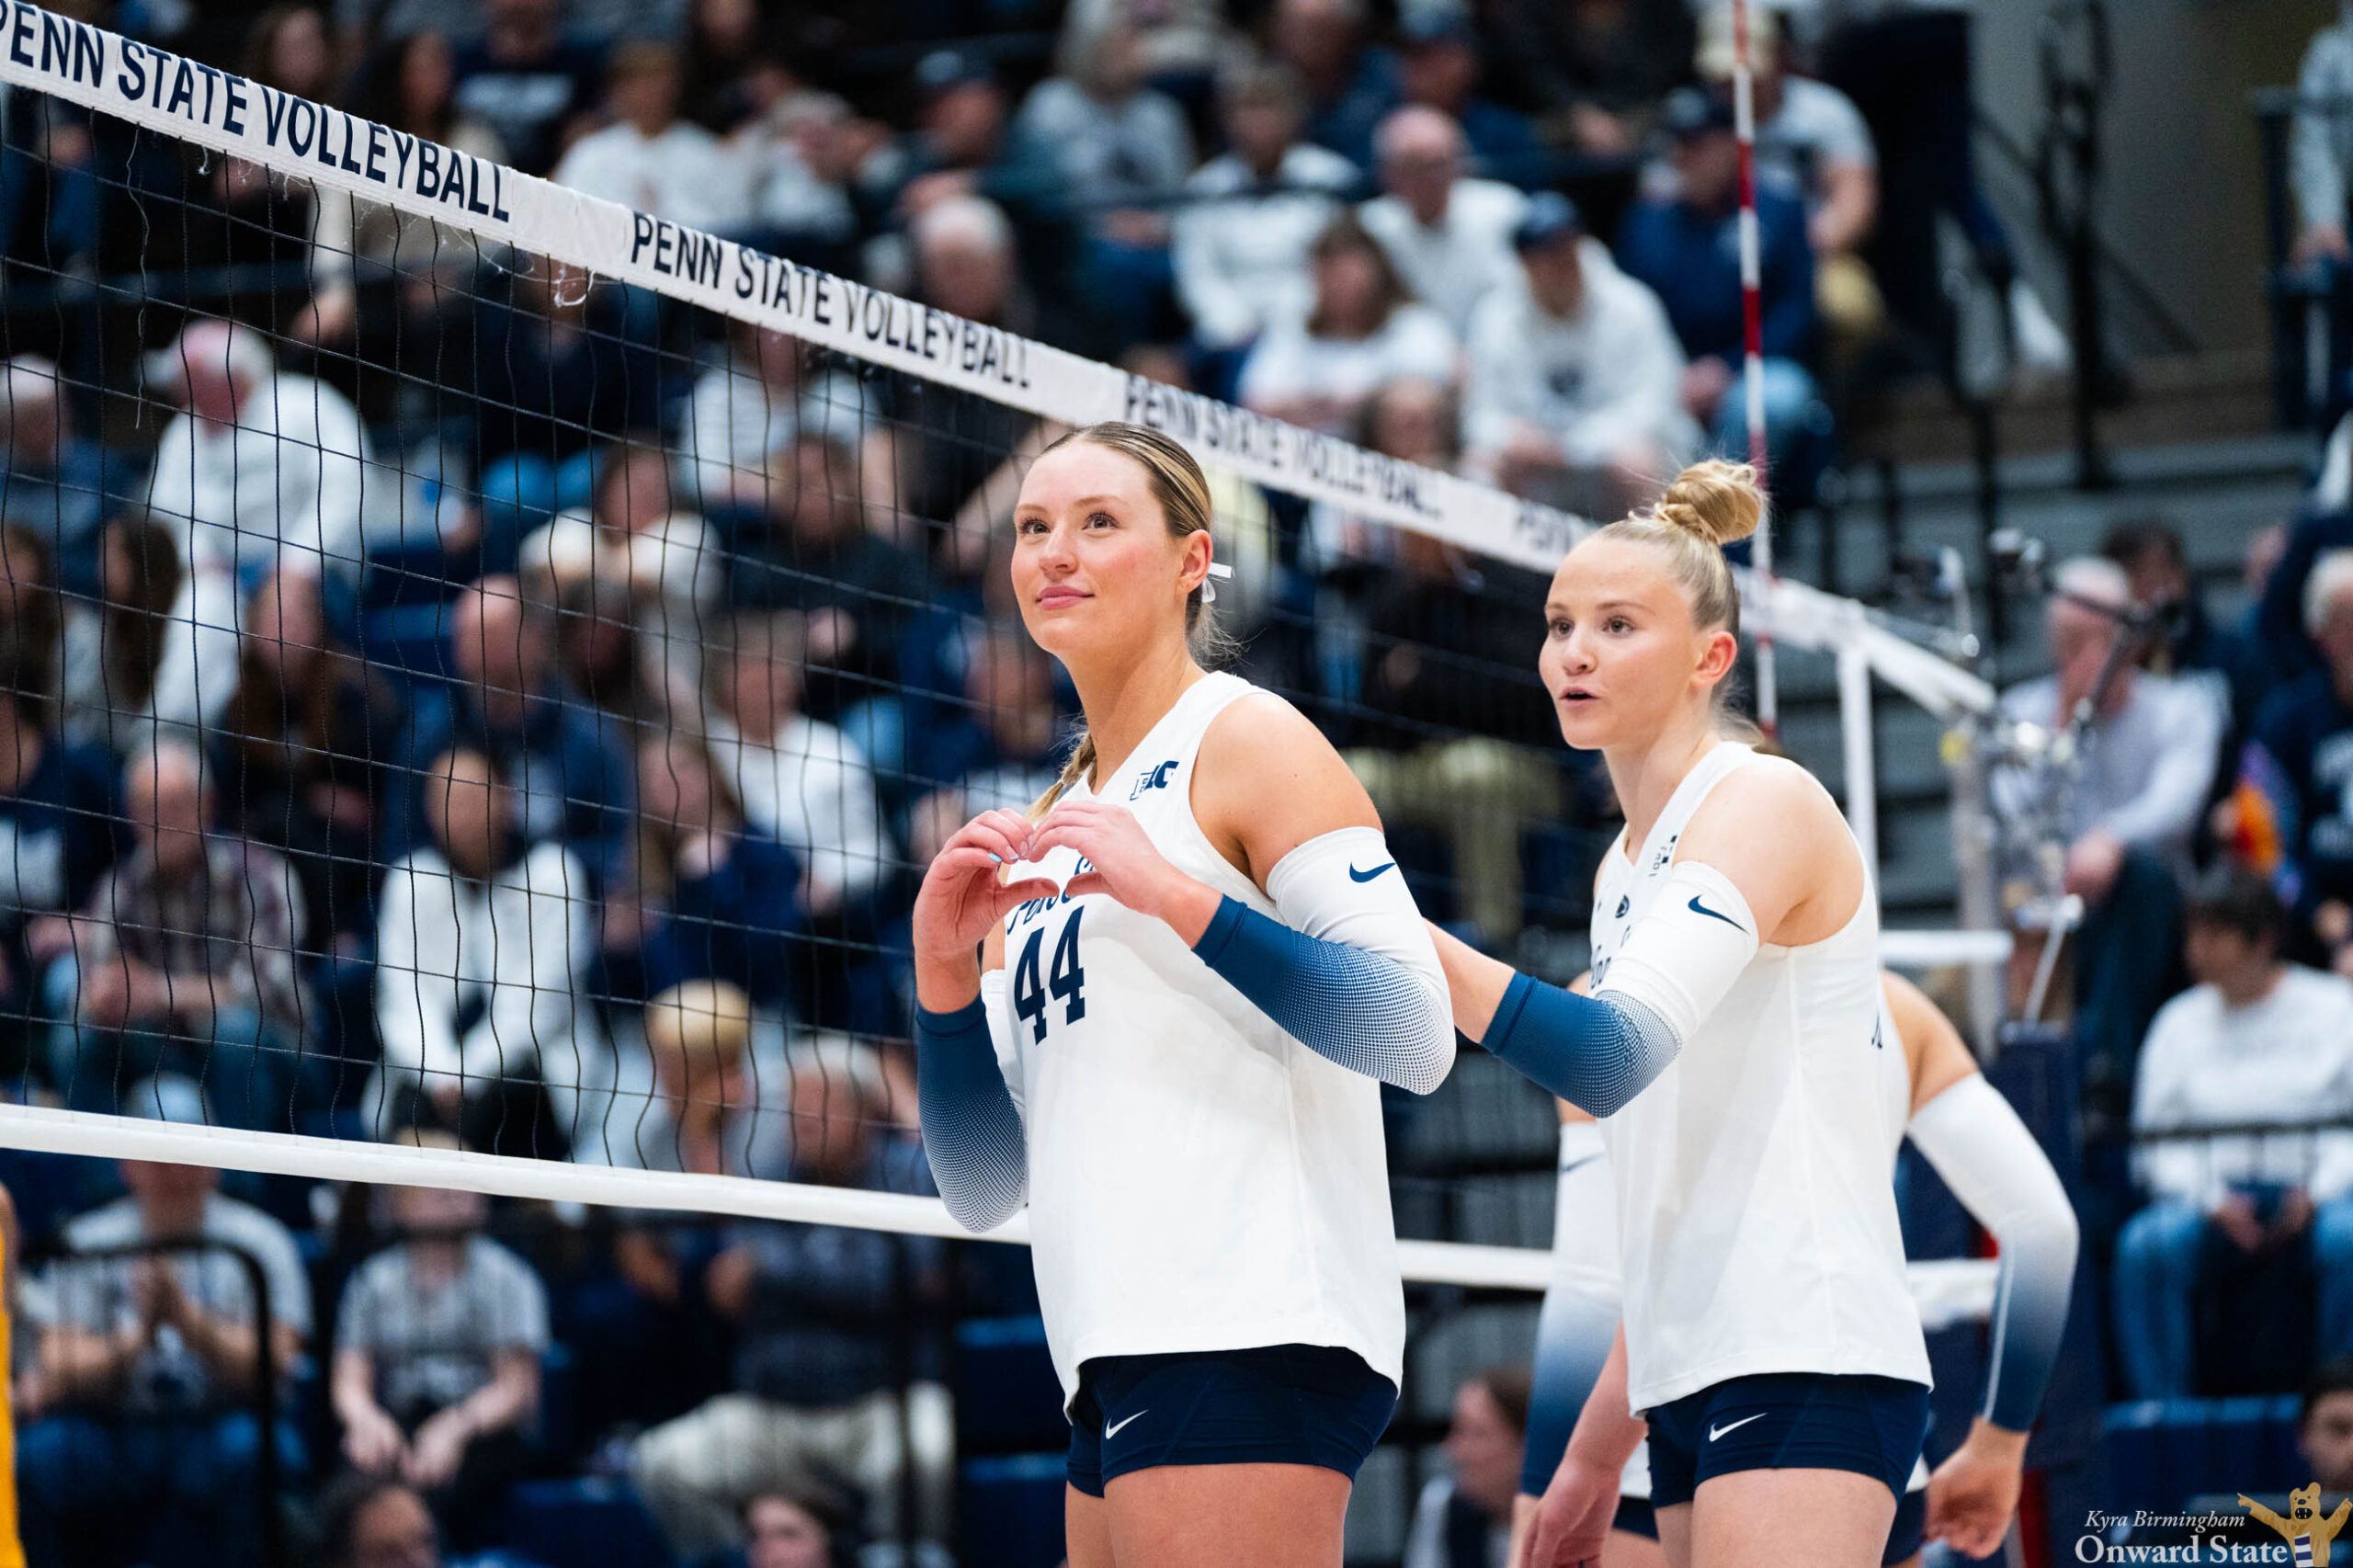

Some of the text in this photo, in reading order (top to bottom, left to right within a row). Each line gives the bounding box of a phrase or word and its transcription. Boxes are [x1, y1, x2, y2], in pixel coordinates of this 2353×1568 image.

[118, 38, 248, 136] STATE
[260, 85, 510, 223] VOLLEYBALL
[631, 211, 1031, 390] PENN STATE VOLLEYBALL
[1014, 904, 1086, 1046] 44
